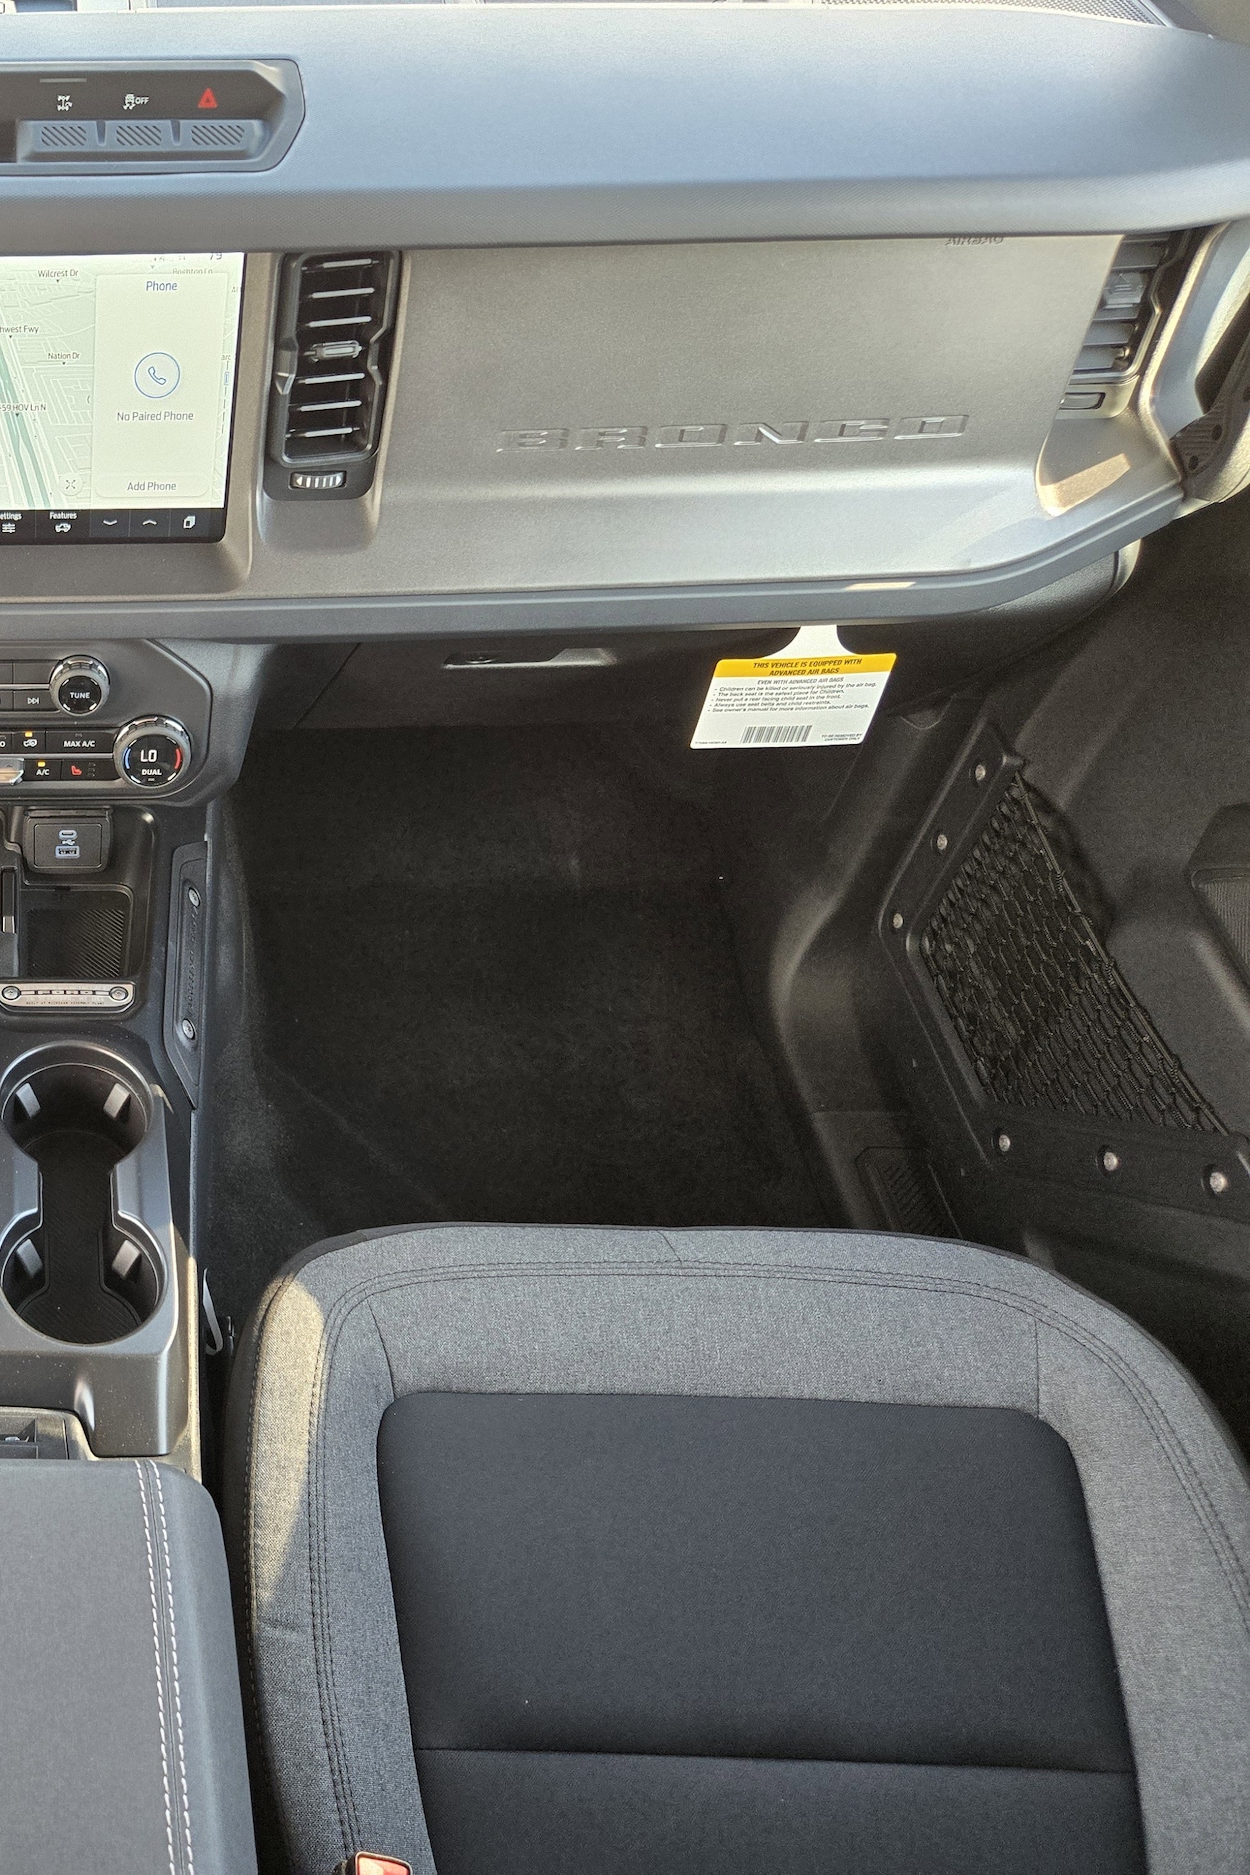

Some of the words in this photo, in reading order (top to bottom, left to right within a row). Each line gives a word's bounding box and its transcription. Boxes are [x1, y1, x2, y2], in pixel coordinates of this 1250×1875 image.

[37, 269, 69, 278] Wilcrest
[69, 269, 79, 277] Dr
[146, 281, 178, 291] Phone
[23, 325, 39, 334] Fwy
[117, 411, 131, 421] No
[132, 411, 162, 421] Paired
[163, 411, 194, 421] Phone
[496, 414, 970, 453] BRONCO
[127, 482, 146, 491] Add
[147, 482, 177, 491] Phone
[50, 511, 77, 520] Features
[82, 740, 96, 748] A/C
[140, 750, 158, 762] LO
